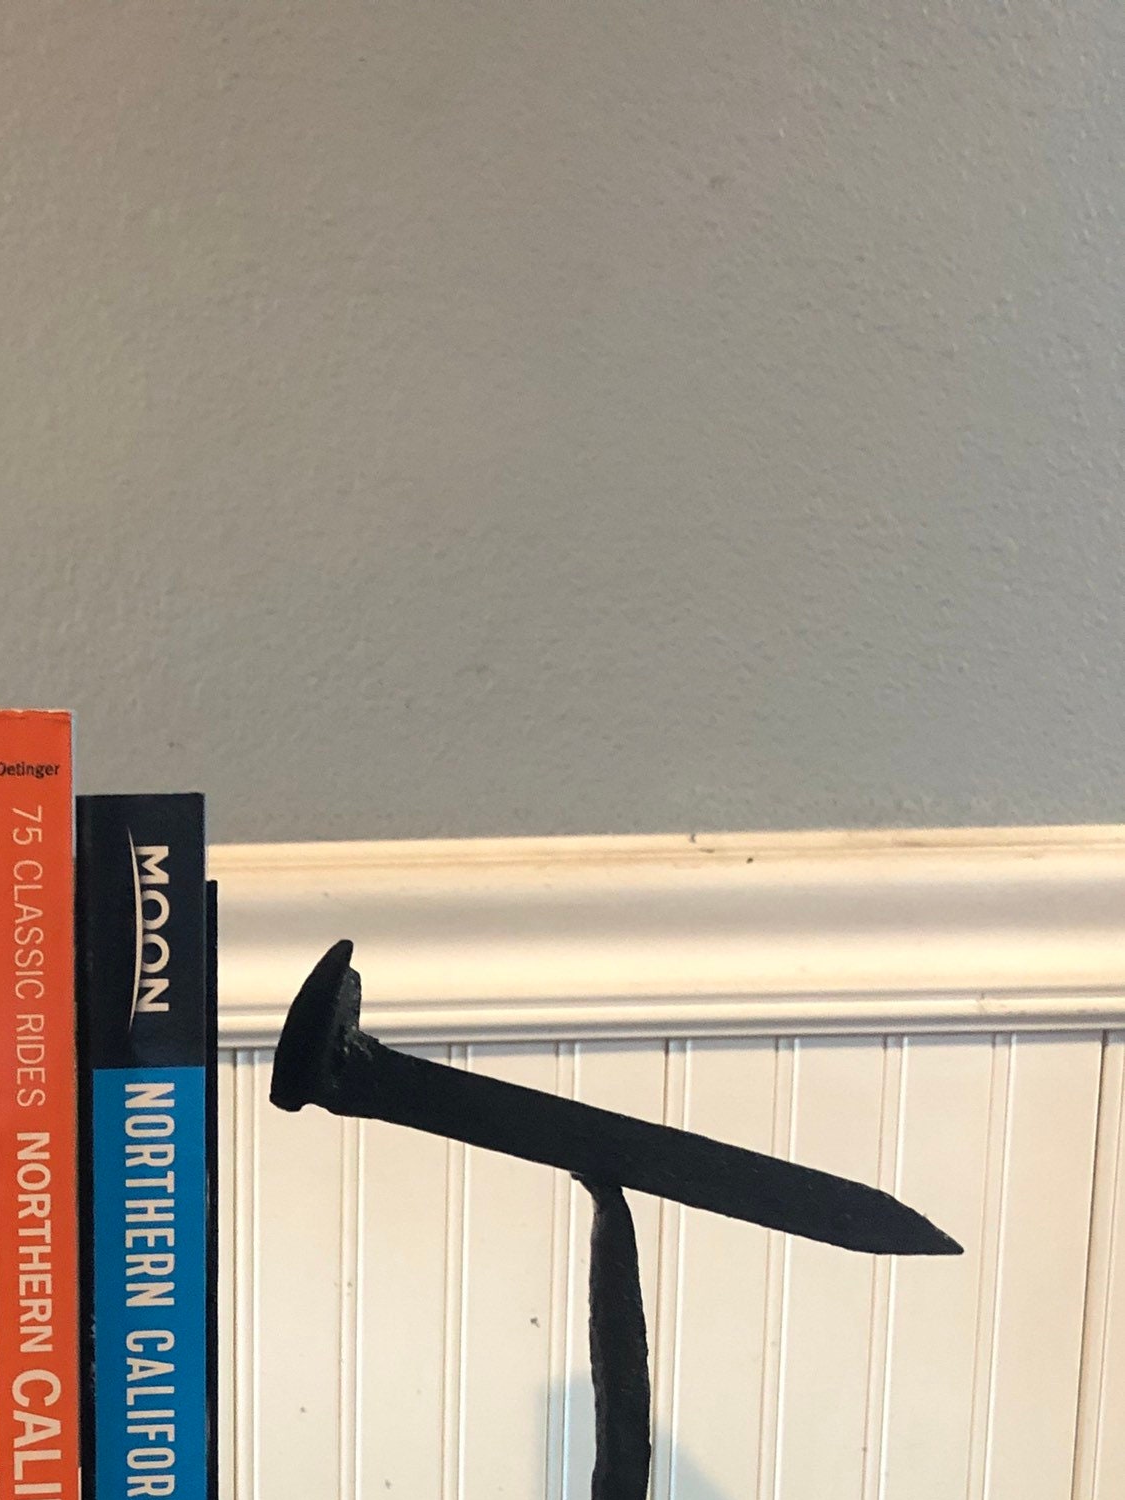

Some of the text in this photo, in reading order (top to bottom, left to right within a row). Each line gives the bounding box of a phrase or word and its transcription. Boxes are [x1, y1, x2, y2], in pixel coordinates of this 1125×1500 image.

[11, 805, 43, 846] 75
[12, 860, 46, 1001] CLASSIC
[135, 844, 170, 1014] MOON
[15, 1013, 47, 1108] RIDES
[16, 1131, 53, 1353] NORTHERN
[124, 1082, 175, 1307] NORTHERN
